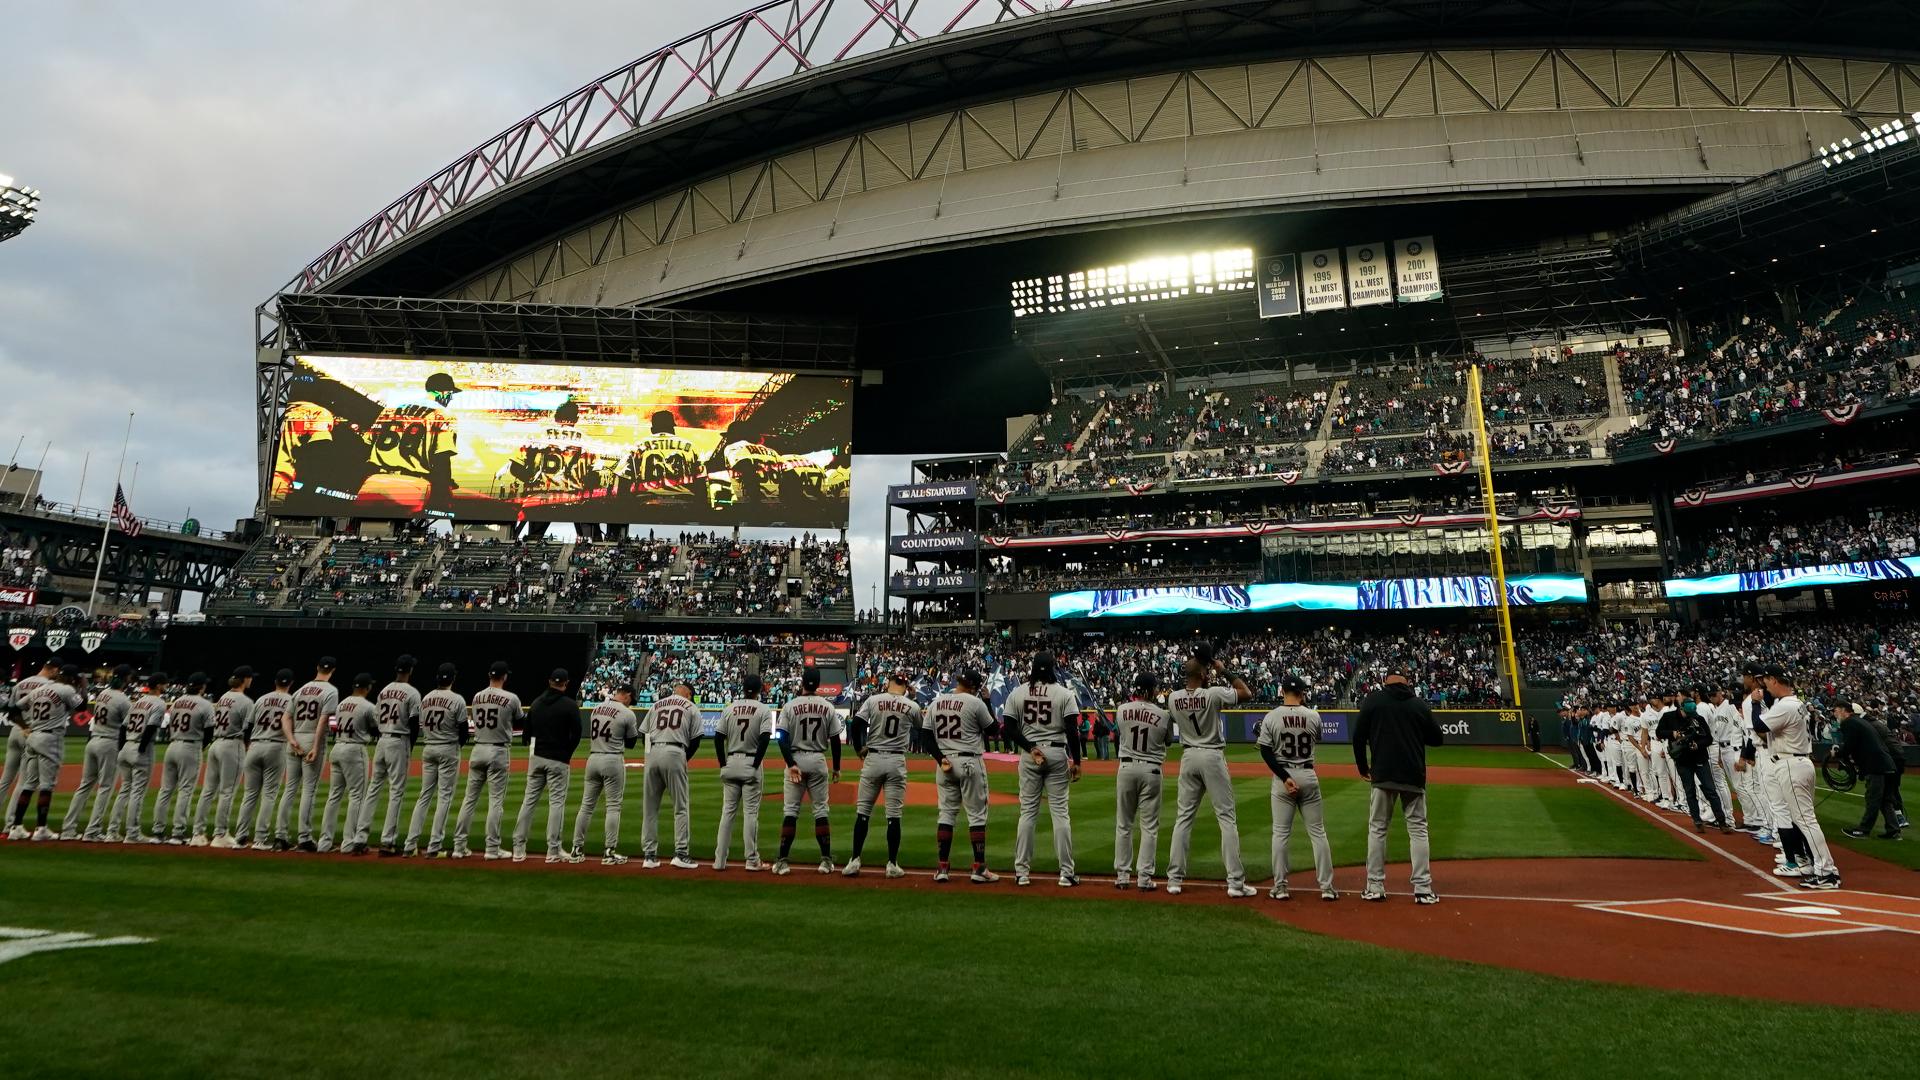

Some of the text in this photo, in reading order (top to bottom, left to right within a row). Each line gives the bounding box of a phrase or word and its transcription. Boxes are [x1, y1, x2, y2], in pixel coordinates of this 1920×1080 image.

[1359, 265, 1377, 277] 1997
[1407, 259, 1426, 271] 2001
[1312, 270, 1332, 283] 1995
[1354, 277, 1384, 289] A.L. WEST
[1402, 271, 1433, 283] A.L. WEST
[1309, 283, 1338, 294] A.L. WEST
[1352, 288, 1390, 301] CHAMPIONS
[1400, 282, 1439, 295] CHAMPIONS
[1306, 293, 1343, 306] CHAMPIONS
[944, 486, 967, 496] WEEK
[901, 537, 965, 549] COUNTDOWN
[917, 576, 963, 587] 99 DAYS
[13, 635, 27, 646] 42
[50, 637, 62, 646] 24
[87, 638, 96, 648] 11
[1028, 685, 1049, 697] BELL
[33, 701, 51, 720] 62
[296, 700, 320, 721] 29
[732, 704, 758, 717] STRAW
[792, 703, 829, 716] BRENNAN
[877, 700, 912, 716] GIMÉNEZ
[936, 701, 964, 713] NAYLOR
[1174, 696, 1207, 712] ROSARIO
[215, 710, 229, 731] 34
[257, 709, 283, 731] 43
[380, 703, 400, 724] 24
[425, 710, 444, 731] 47
[476, 708, 499, 730] 35
[656, 708, 684, 731] 60
[1023, 700, 1052, 726] 55
[1122, 706, 1162, 728] RAMÍREZ
[1499, 711, 1517, 722] 326
[127, 713, 145, 733] 52
[171, 712, 191, 733] 49
[337, 717, 354, 739] 44
[737, 718, 749, 741] 7
[799, 717, 821, 741] 17
[884, 714, 900, 738] 0
[935, 714, 962, 739] 22
[1188, 711, 1202, 737] 1
[1282, 715, 1307, 729] KWAN
[1321, 721, 1340, 729] EDIT
[1440, 720, 1470, 735] soft
[591, 718, 613, 743] 84
[1130, 725, 1149, 752] 11
[1280, 731, 1312, 759] 38
